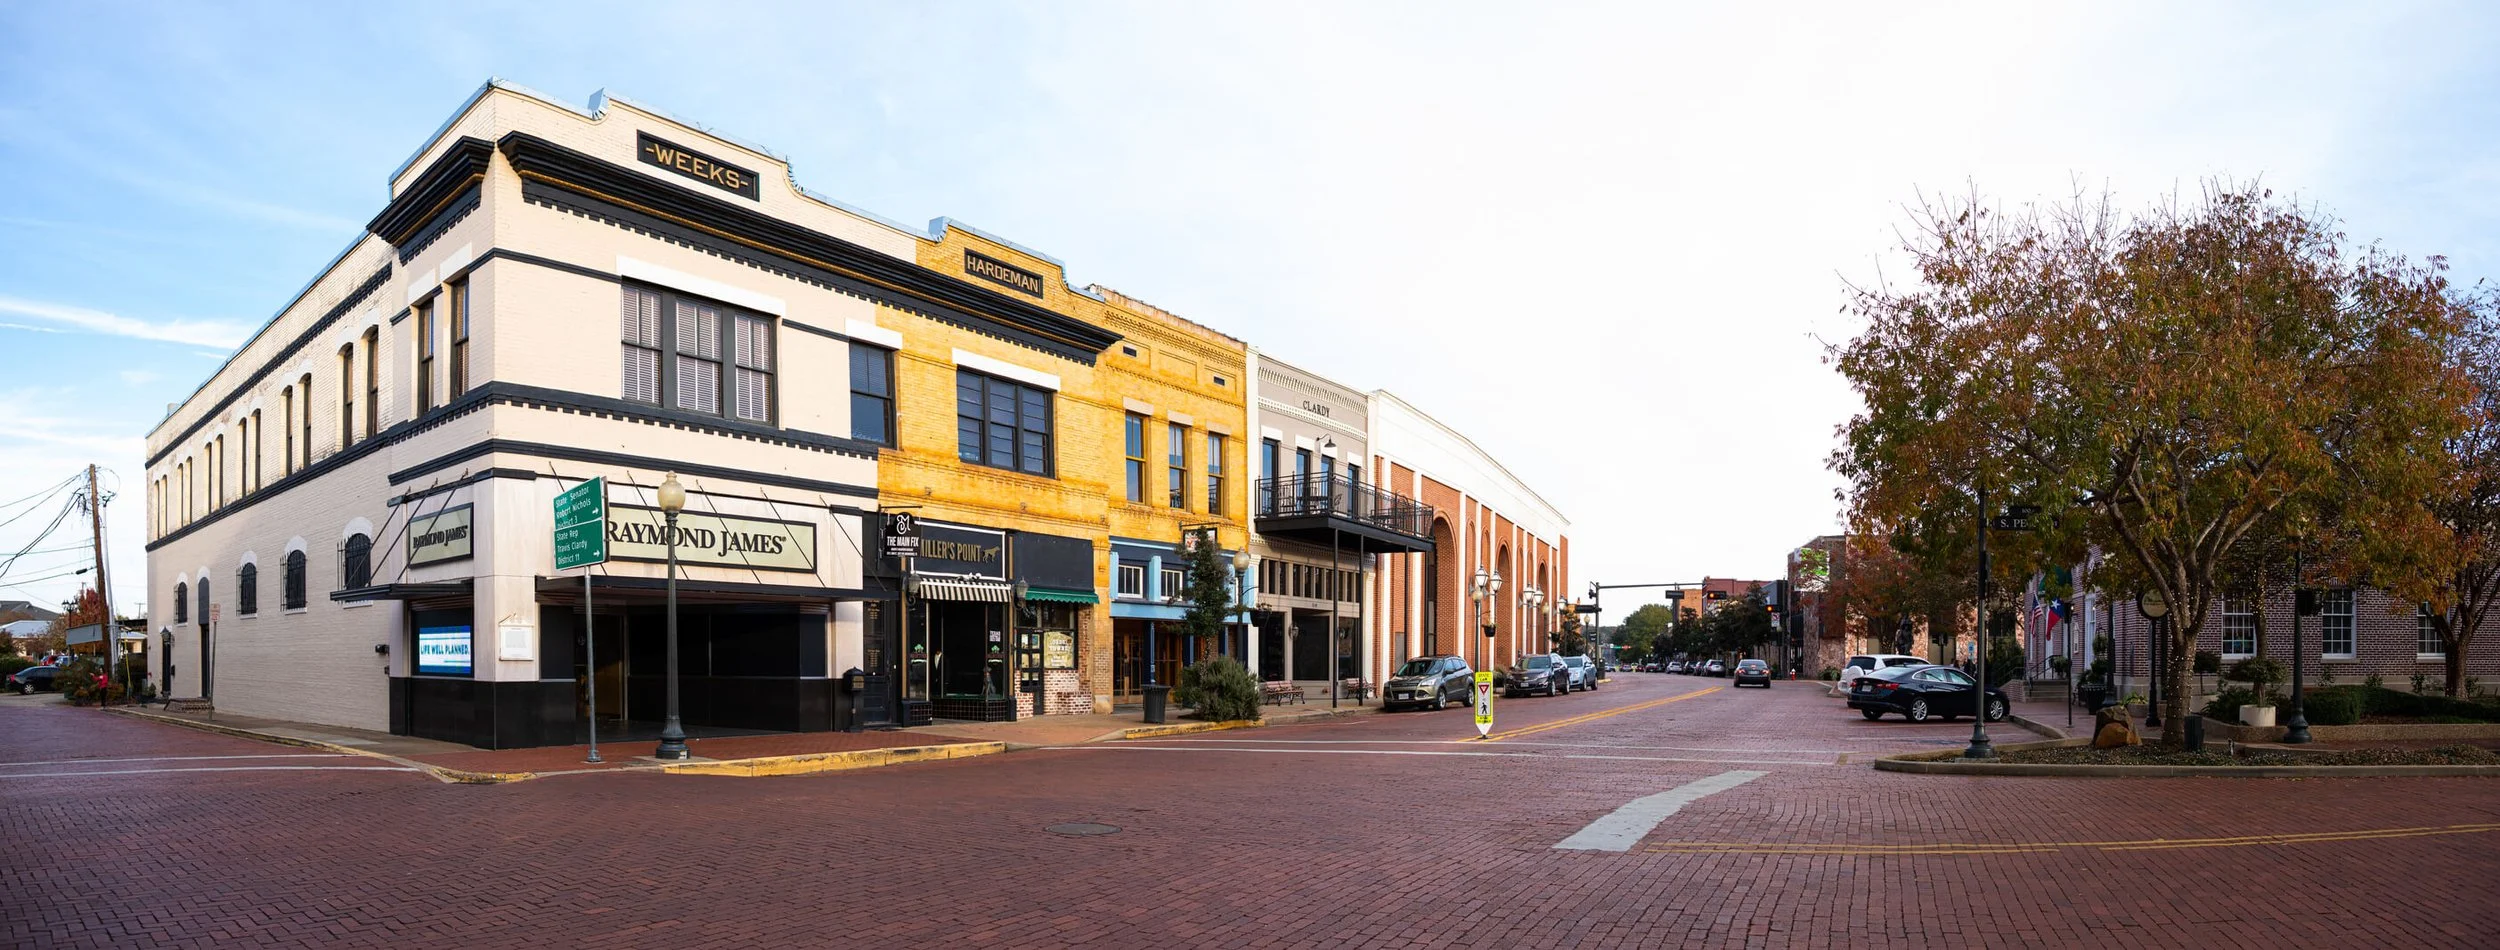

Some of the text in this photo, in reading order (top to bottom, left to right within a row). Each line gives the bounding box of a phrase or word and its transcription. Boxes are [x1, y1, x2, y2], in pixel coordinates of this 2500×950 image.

[967, 255, 1038, 292] HARDEMAN
[1303, 400, 1330, 418] CLARDY
[556, 486, 589, 508] State Senator
[557, 498, 591, 519] Robert Nichols
[575, 516, 578, 524] 3
[413, 530, 444, 549] RAYMOND
[557, 530, 578, 541] State Rep
[608, 521, 715, 549] RAYMOND
[887, 536, 920, 547] THE MAIN FIX
[557, 540, 588, 552] Travis Clardy
[957, 543, 981, 562] POINT
[558, 553, 580, 565] District 11
[420, 644, 430, 655] LIFE
[431, 644, 444, 655] WELL
